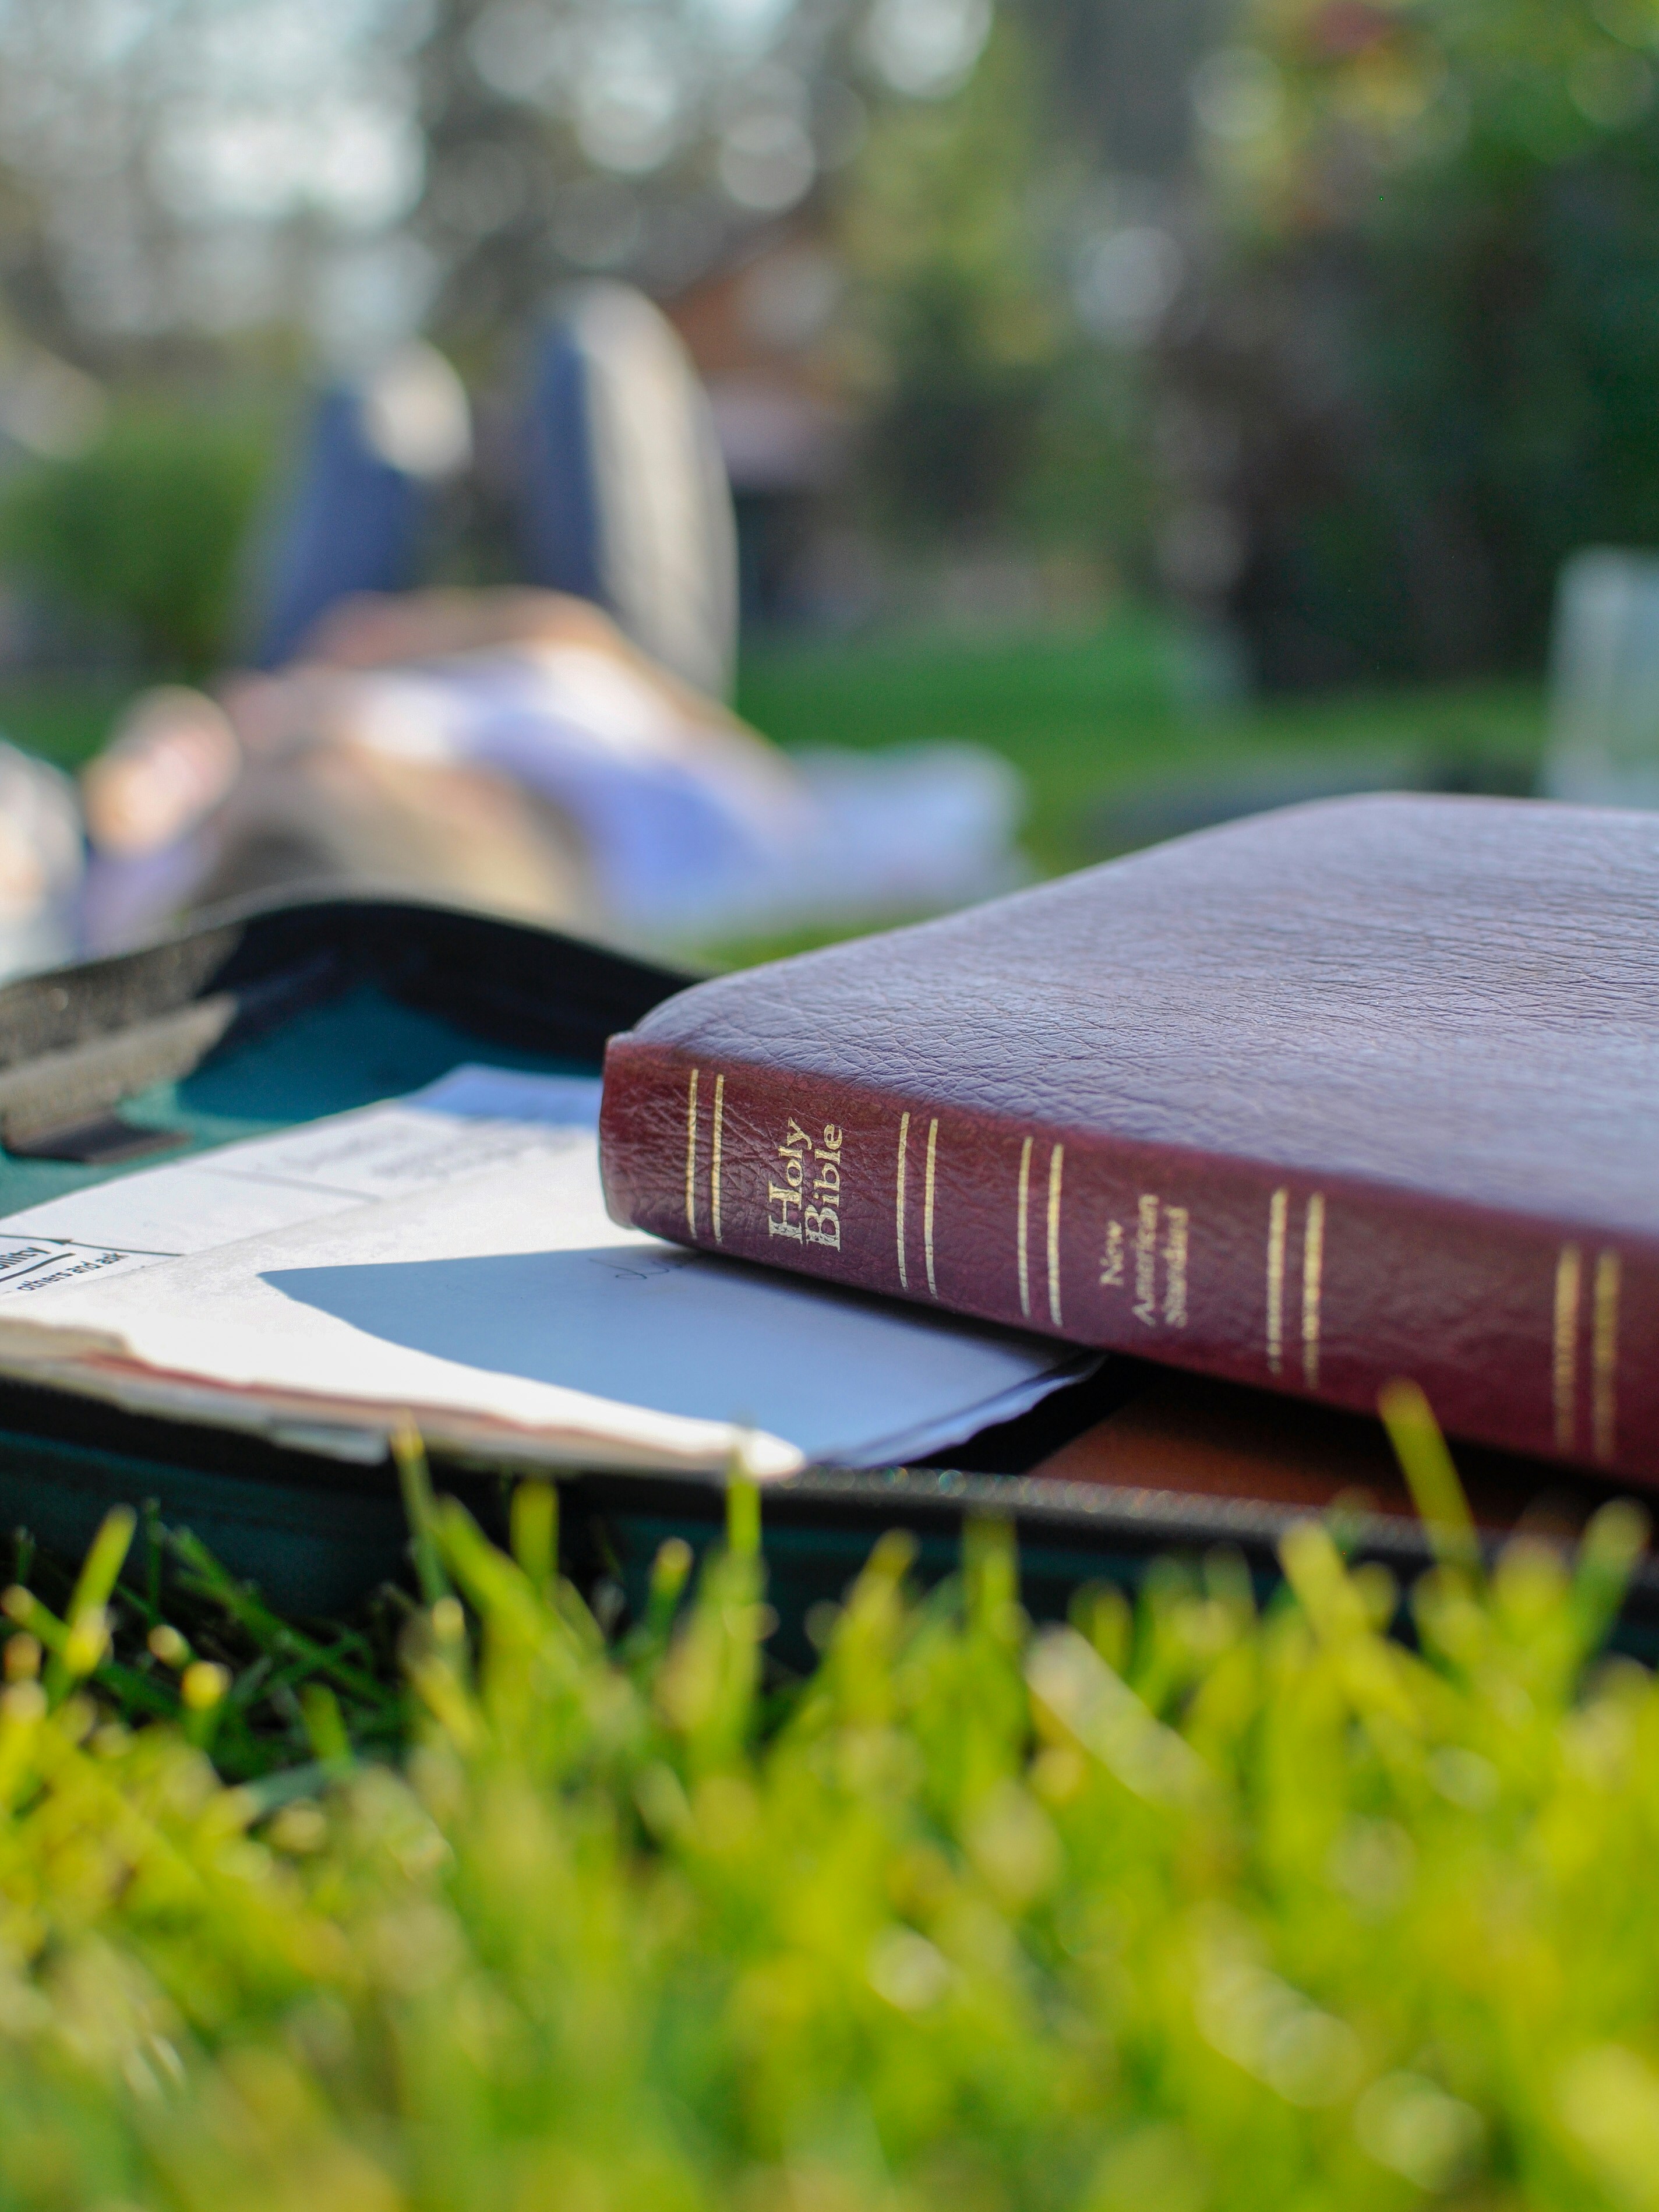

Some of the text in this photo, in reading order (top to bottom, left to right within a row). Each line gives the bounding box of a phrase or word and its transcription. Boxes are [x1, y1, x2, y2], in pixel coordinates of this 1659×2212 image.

[769, 1116, 812, 1245] Holy
[803, 1123, 843, 1252] Bible
[16, 1271, 73, 1291] others
[66, 1261, 104, 1274] and
[1099, 1220, 1125, 1287] New
[1131, 1194, 1160, 1327] American
[1162, 1206, 1189, 1329] Standard
